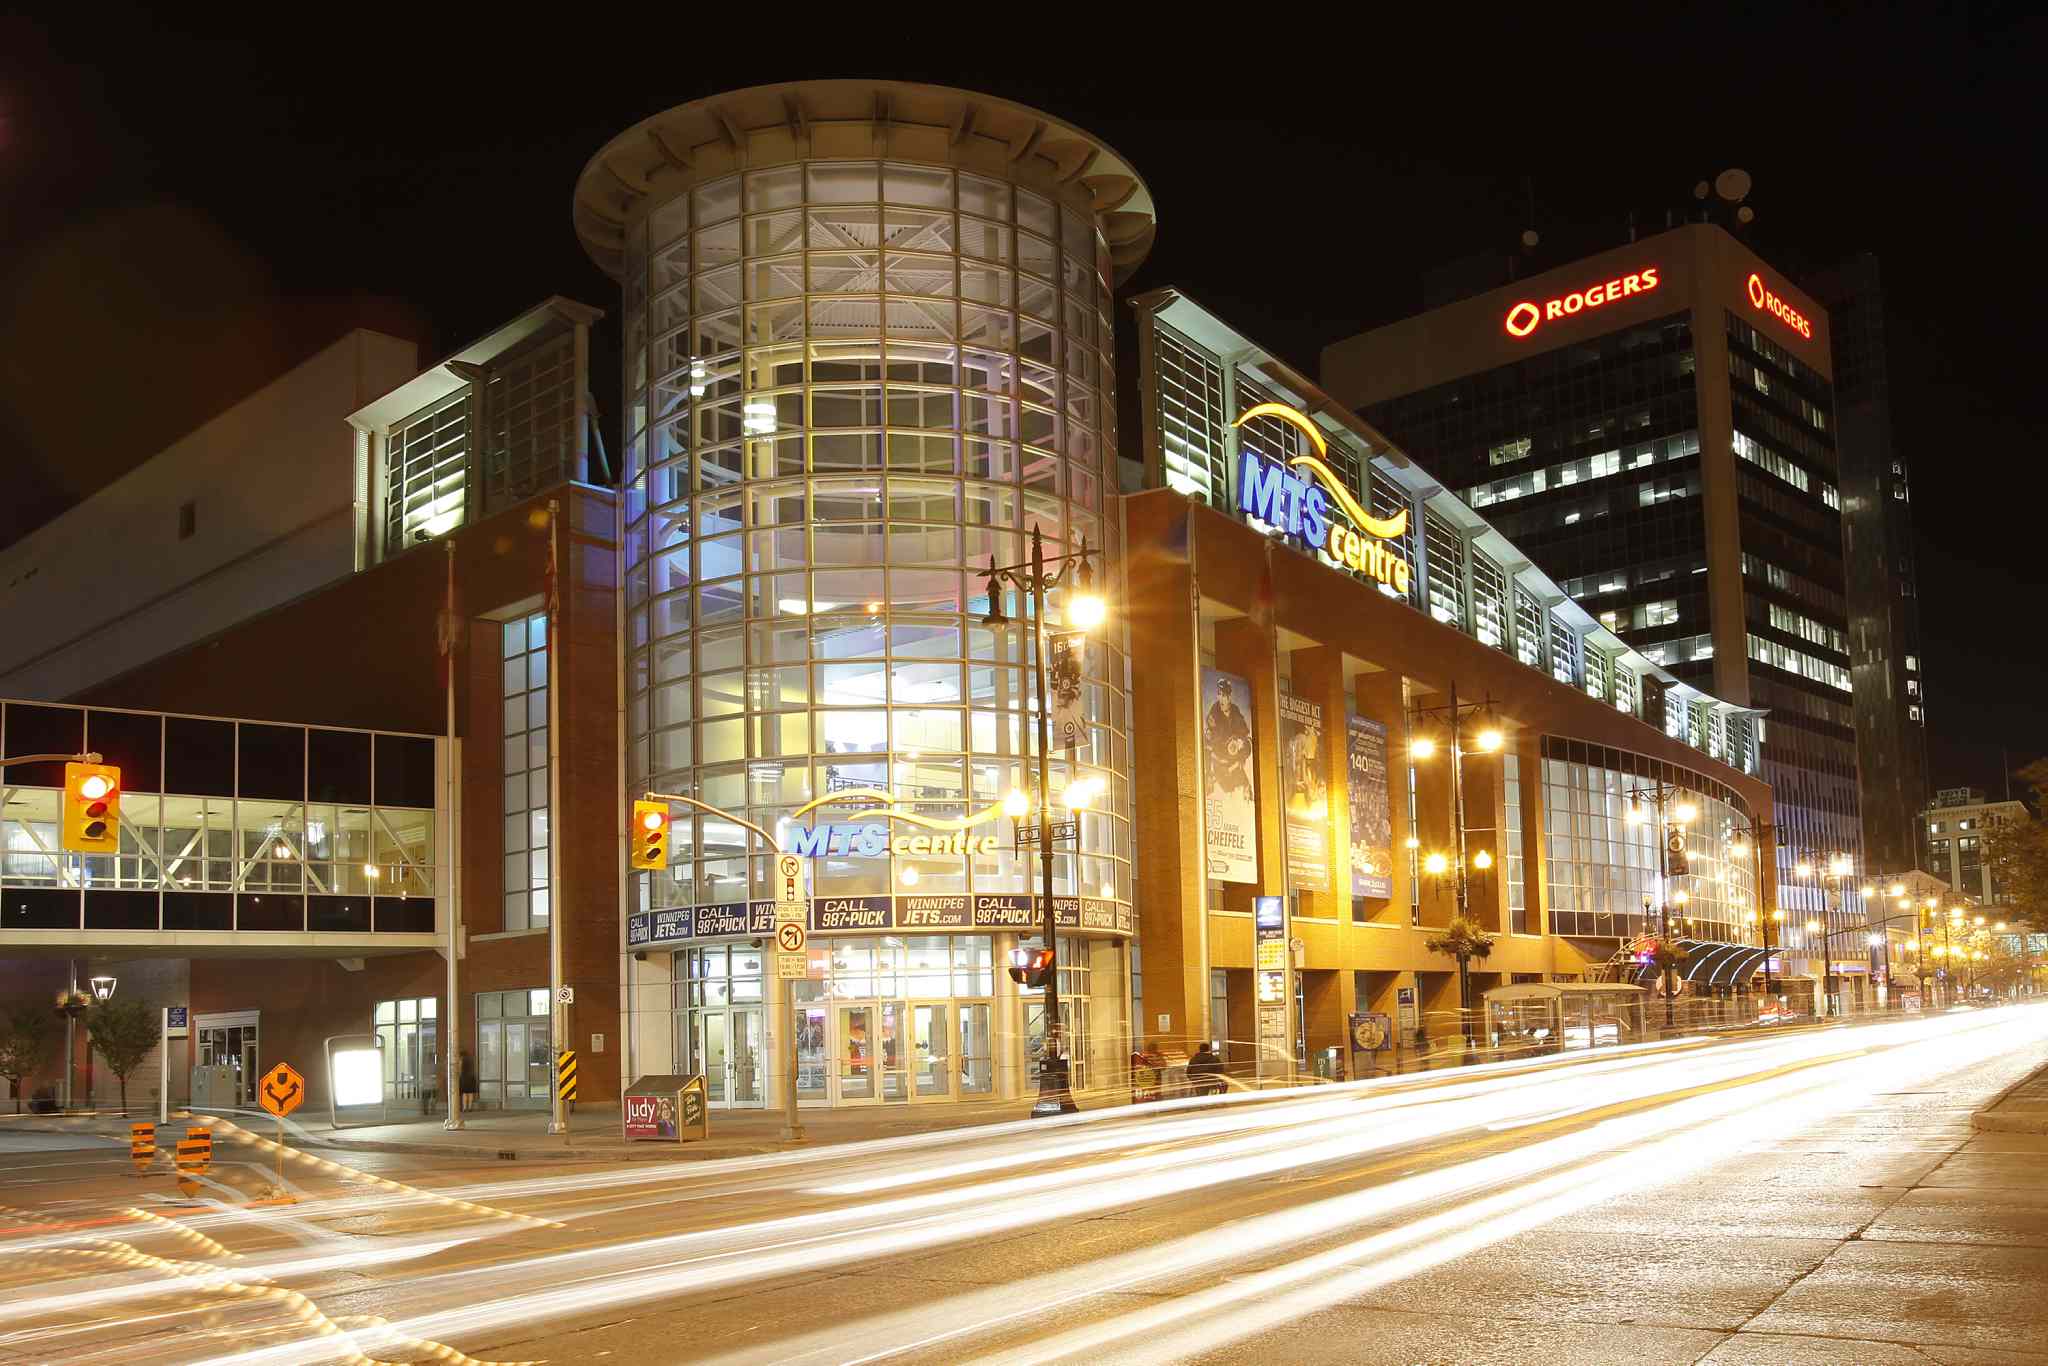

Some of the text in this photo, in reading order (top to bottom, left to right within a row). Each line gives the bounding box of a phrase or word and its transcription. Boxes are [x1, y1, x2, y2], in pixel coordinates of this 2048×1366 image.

[1546, 268, 1659, 320] ROGERS
[1765, 291, 1811, 339] ROGERS
[1240, 452, 1409, 593] MTS centre
[1350, 752, 1369, 772] 140
[791, 824, 1001, 857] MTS centre
[1207, 831, 1244, 849] CHEIFELE
[824, 900, 869, 912] CALL
[907, 898, 964, 910] WINNIPEG
[978, 898, 1017, 909] CALL
[1084, 901, 1106, 913] CALL
[657, 910, 690, 924] WINNIPEG
[699, 906, 733, 920] CALL
[630, 918, 644, 929] CALL
[626, 1097, 655, 1123] Judy
